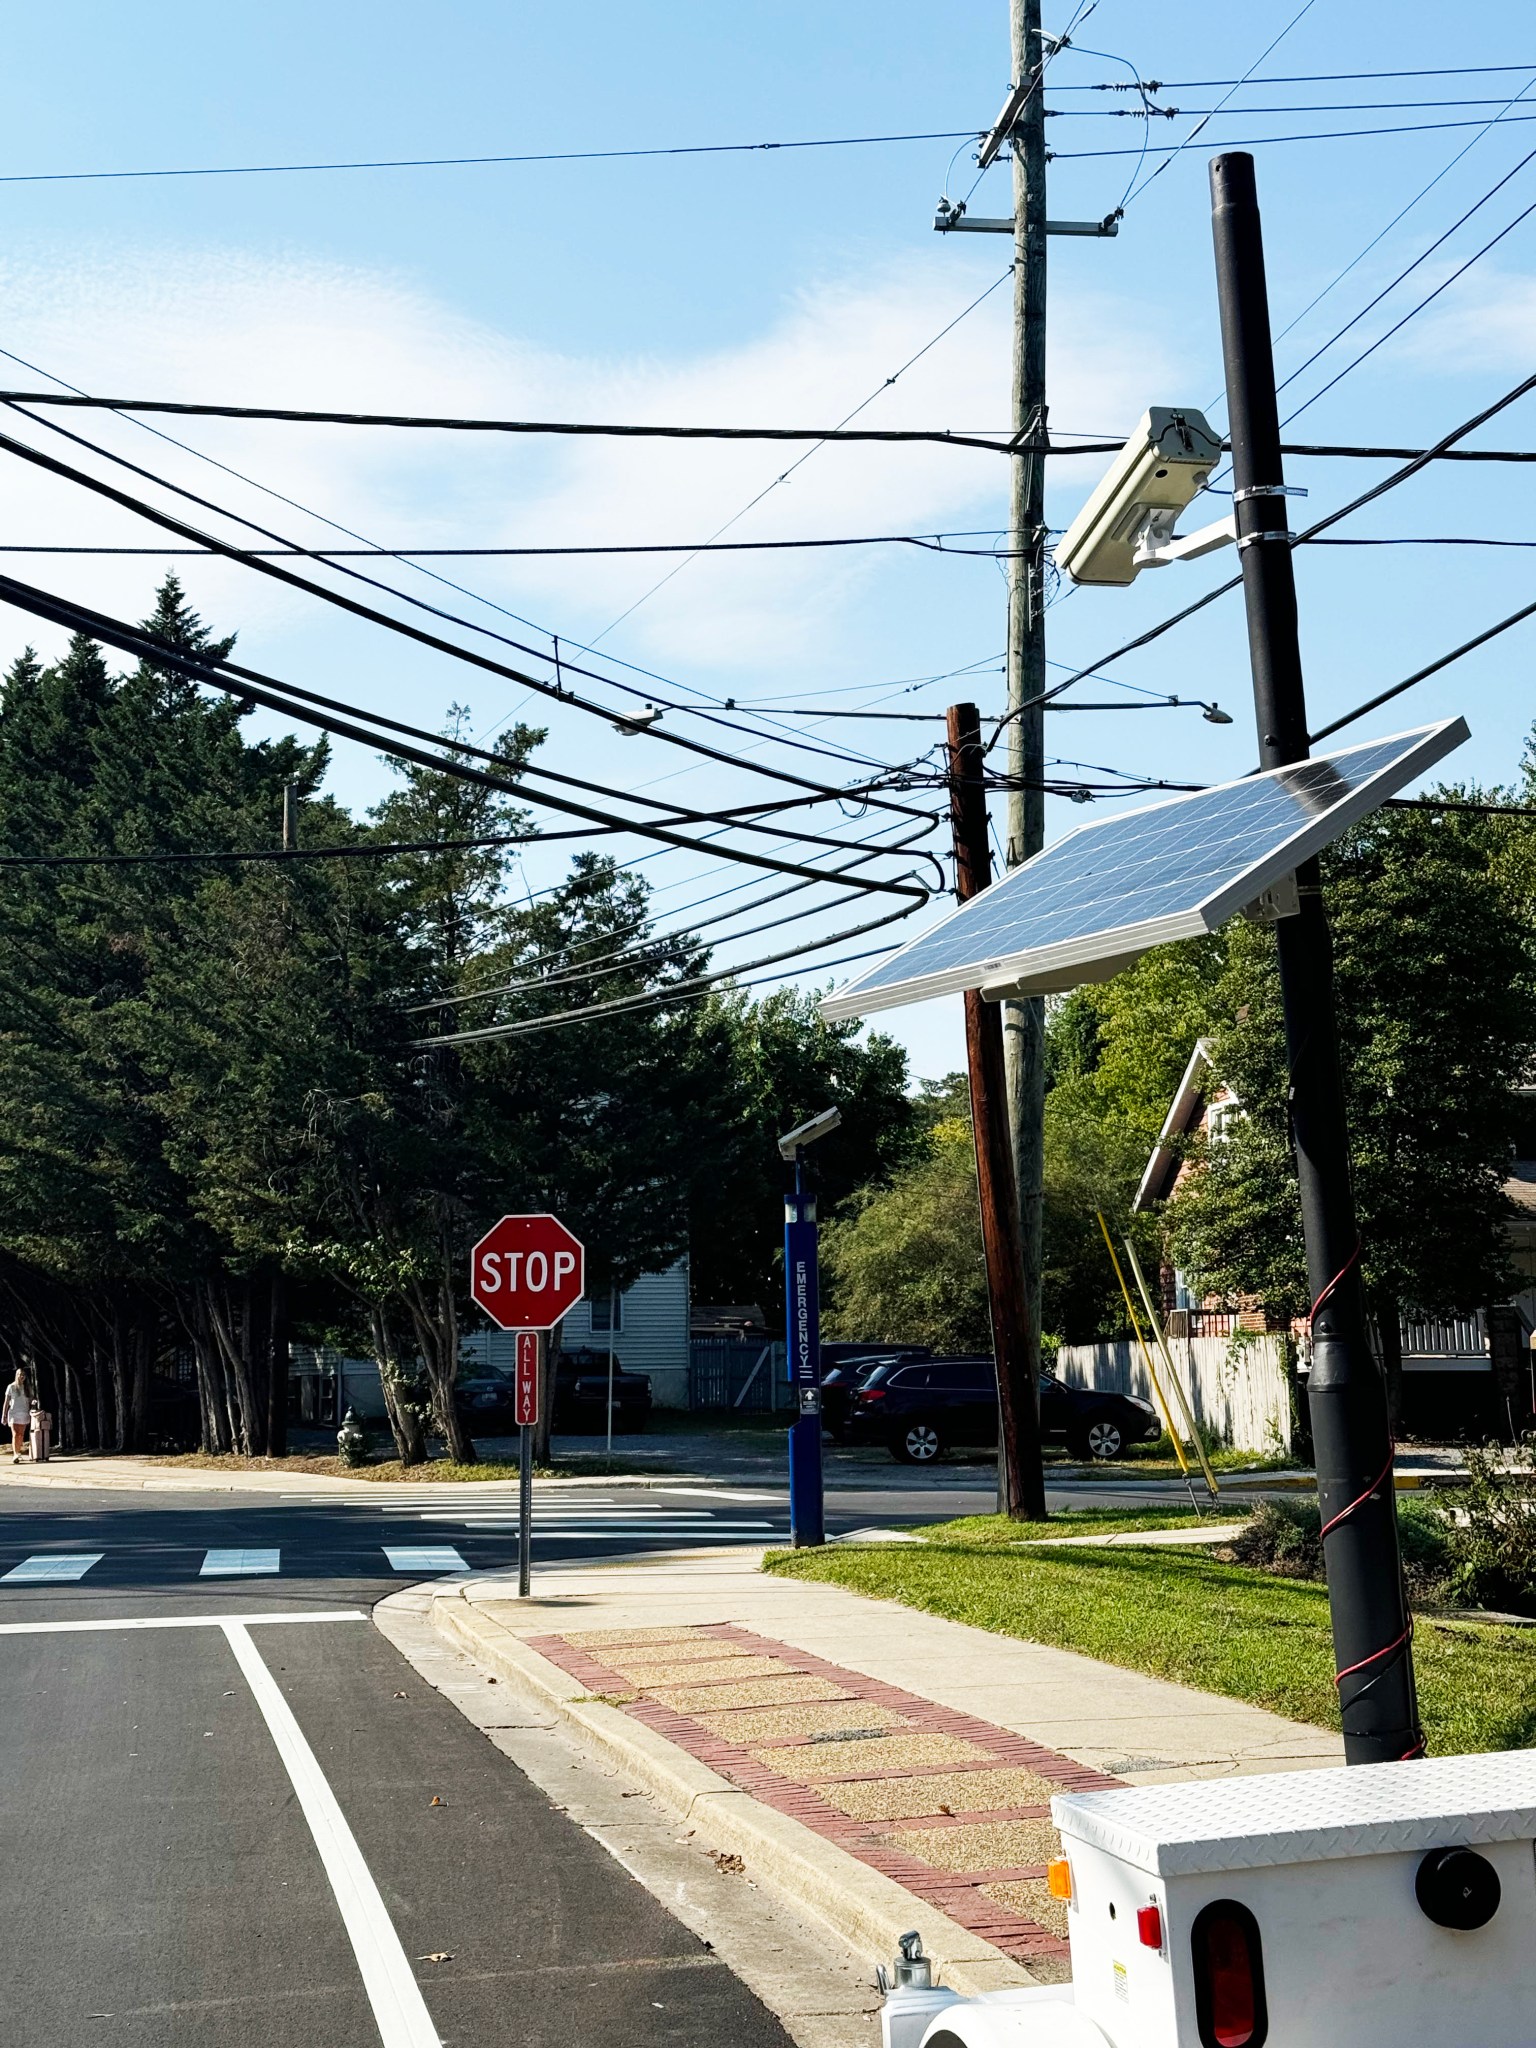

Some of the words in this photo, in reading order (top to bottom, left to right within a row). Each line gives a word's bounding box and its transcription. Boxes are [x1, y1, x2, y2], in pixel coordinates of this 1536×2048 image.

[479, 1251, 576, 1293] STOP
[796, 1261, 809, 1366] EMERGENCY
[522, 1335, 532, 1376] ALL
[522, 1381, 532, 1422] WAY
